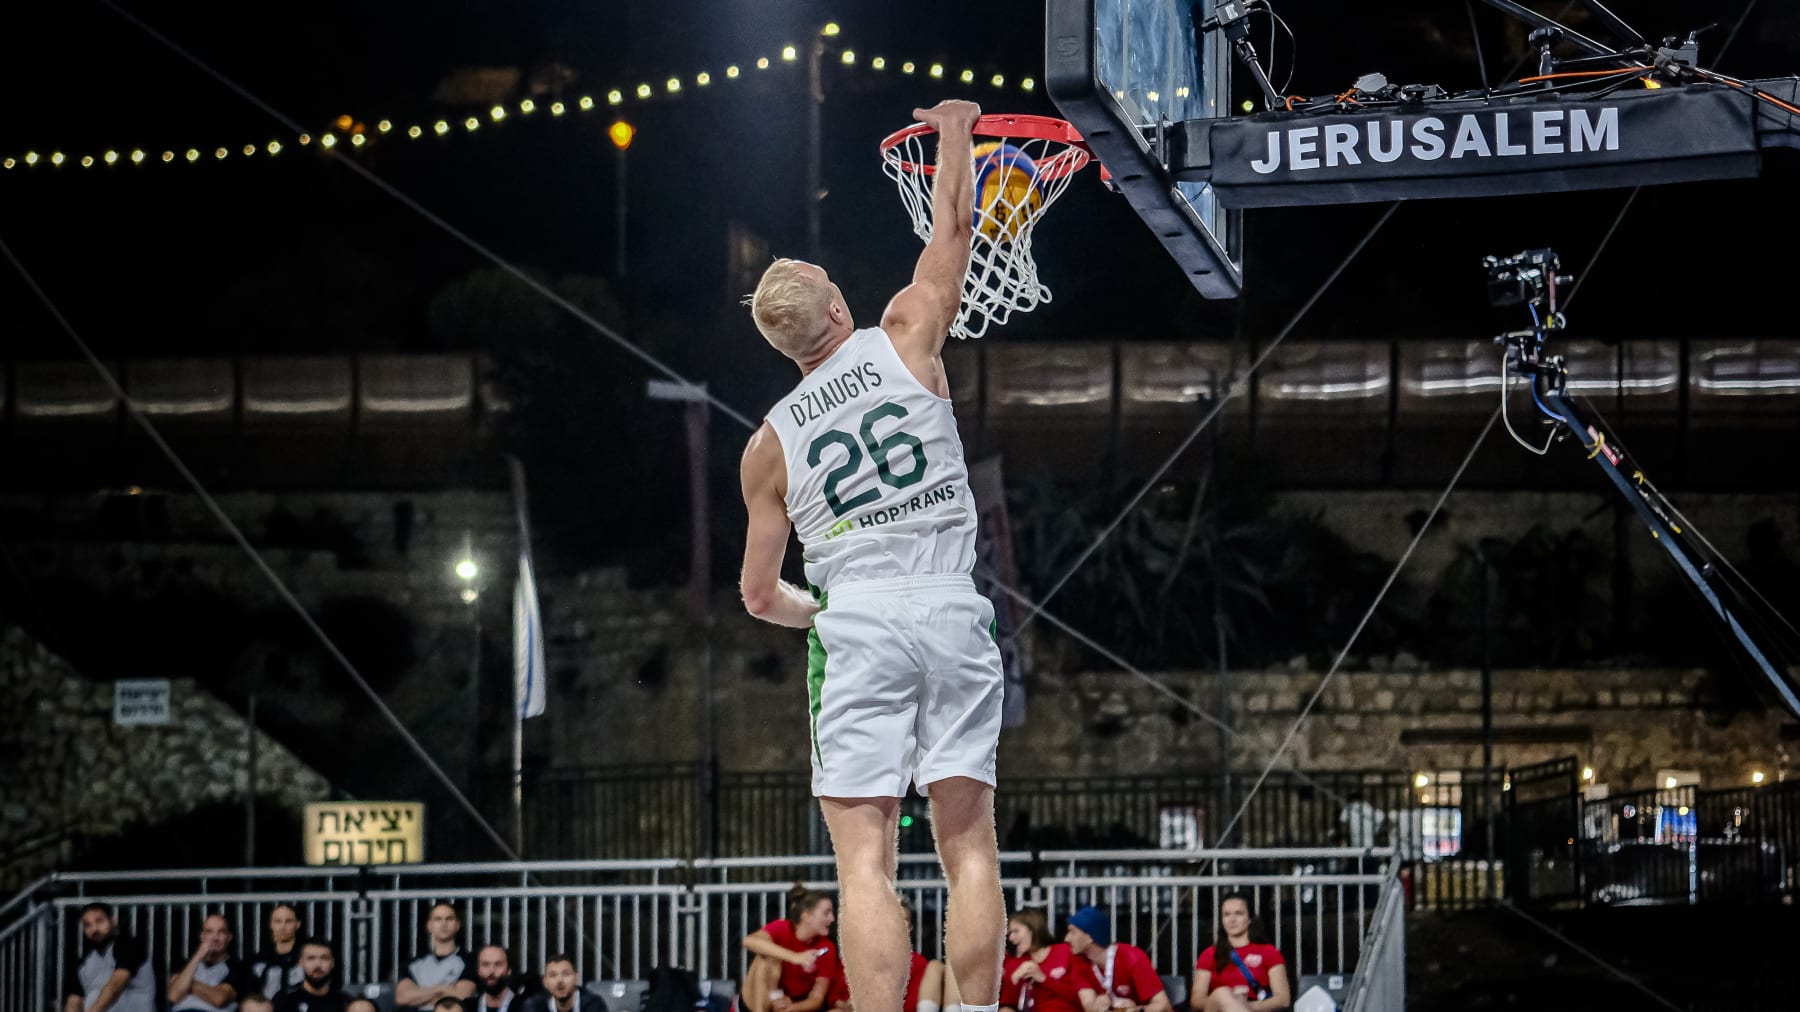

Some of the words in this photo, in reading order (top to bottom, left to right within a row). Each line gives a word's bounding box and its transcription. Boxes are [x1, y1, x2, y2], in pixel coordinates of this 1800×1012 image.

[1251, 107, 1619, 174] JERUSALEM
[790, 362, 882, 427] DŽIAUGYS
[807, 402, 928, 518] 26
[859, 485, 955, 528] HOPTRANS
[319, 809, 413, 833] יציאת
[324, 838, 407, 864] חירום
